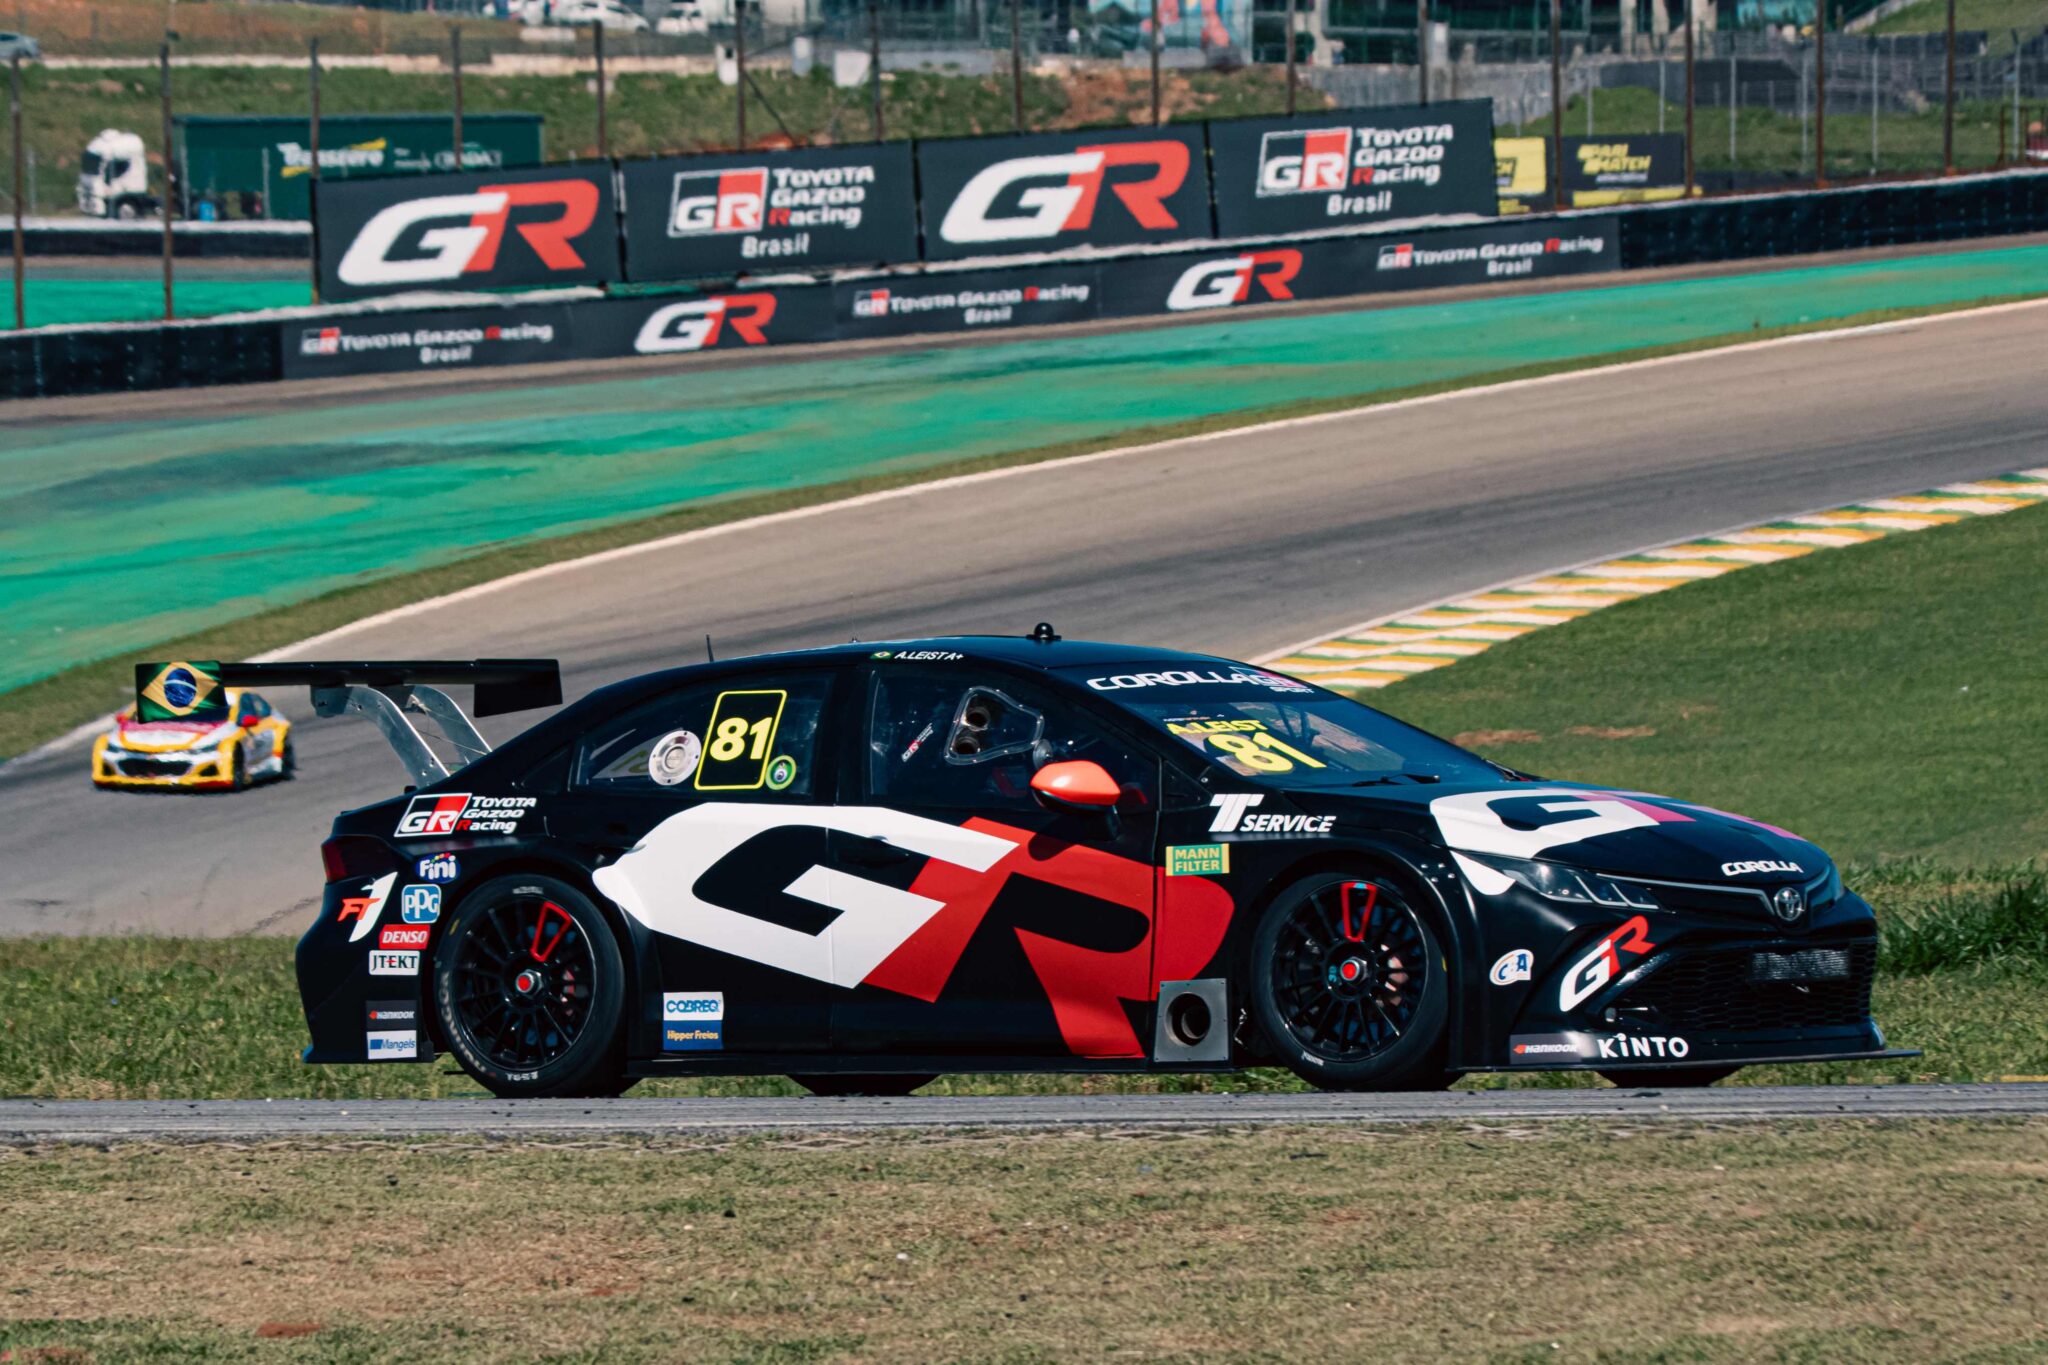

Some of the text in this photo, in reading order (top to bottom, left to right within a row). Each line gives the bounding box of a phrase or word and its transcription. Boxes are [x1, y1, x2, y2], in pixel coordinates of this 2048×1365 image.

[1356, 124, 1454, 147] TOYOTA
[1354, 145, 1444, 166] GAZOO
[773, 166, 875, 187] TOYOTA
[1263, 152, 1343, 189] GR
[1352, 163, 1441, 186] Racing
[770, 186, 865, 208] GAZOO
[940, 140, 1190, 243] GR
[1327, 190, 1392, 215] Brasil
[676, 192, 761, 230] GR
[769, 204, 862, 228] Racing
[338, 179, 600, 285] GR
[741, 233, 809, 258] Brasil
[1414, 247, 1477, 267] TOYOTA
[1479, 241, 1543, 259] GAZOO
[1544, 235, 1604, 253] Racing
[1487, 257, 1533, 276] Brasil
[1167, 249, 1303, 310] GR
[890, 294, 956, 313] TOYOTA
[957, 289, 1022, 307] GAZOO
[1023, 284, 1089, 302] Racing
[634, 293, 776, 353] GR
[964, 306, 1012, 324] Brasil
[341, 332, 410, 351] TOYOTA
[414, 329, 483, 345] GAZOO
[484, 322, 553, 342] Racing
[420, 345, 472, 364] Brasil
[1086, 671, 1258, 691] COROLLA
[710, 717, 772, 761] 81
[1208, 731, 1327, 772] 81
[463, 809, 524, 819] GAZOO
[471, 797, 536, 808] TOYOTA
[400, 810, 458, 833] GR
[456, 819, 517, 834] Racing
[1240, 815, 1336, 832] SERVICE
[1175, 848, 1219, 860] MANN
[1175, 859, 1220, 872] FILTER
[420, 855, 456, 880] Fini
[1721, 860, 1804, 877] COROLLA
[404, 889, 439, 919] PPG
[382, 931, 427, 944] DENSO
[592, 802, 1235, 1059] GR
[372, 955, 417, 971] JTEKT
[1559, 915, 1657, 1012] GR
[666, 1000, 719, 1013] COBREQ
[667, 1029, 694, 1041] Hipper
